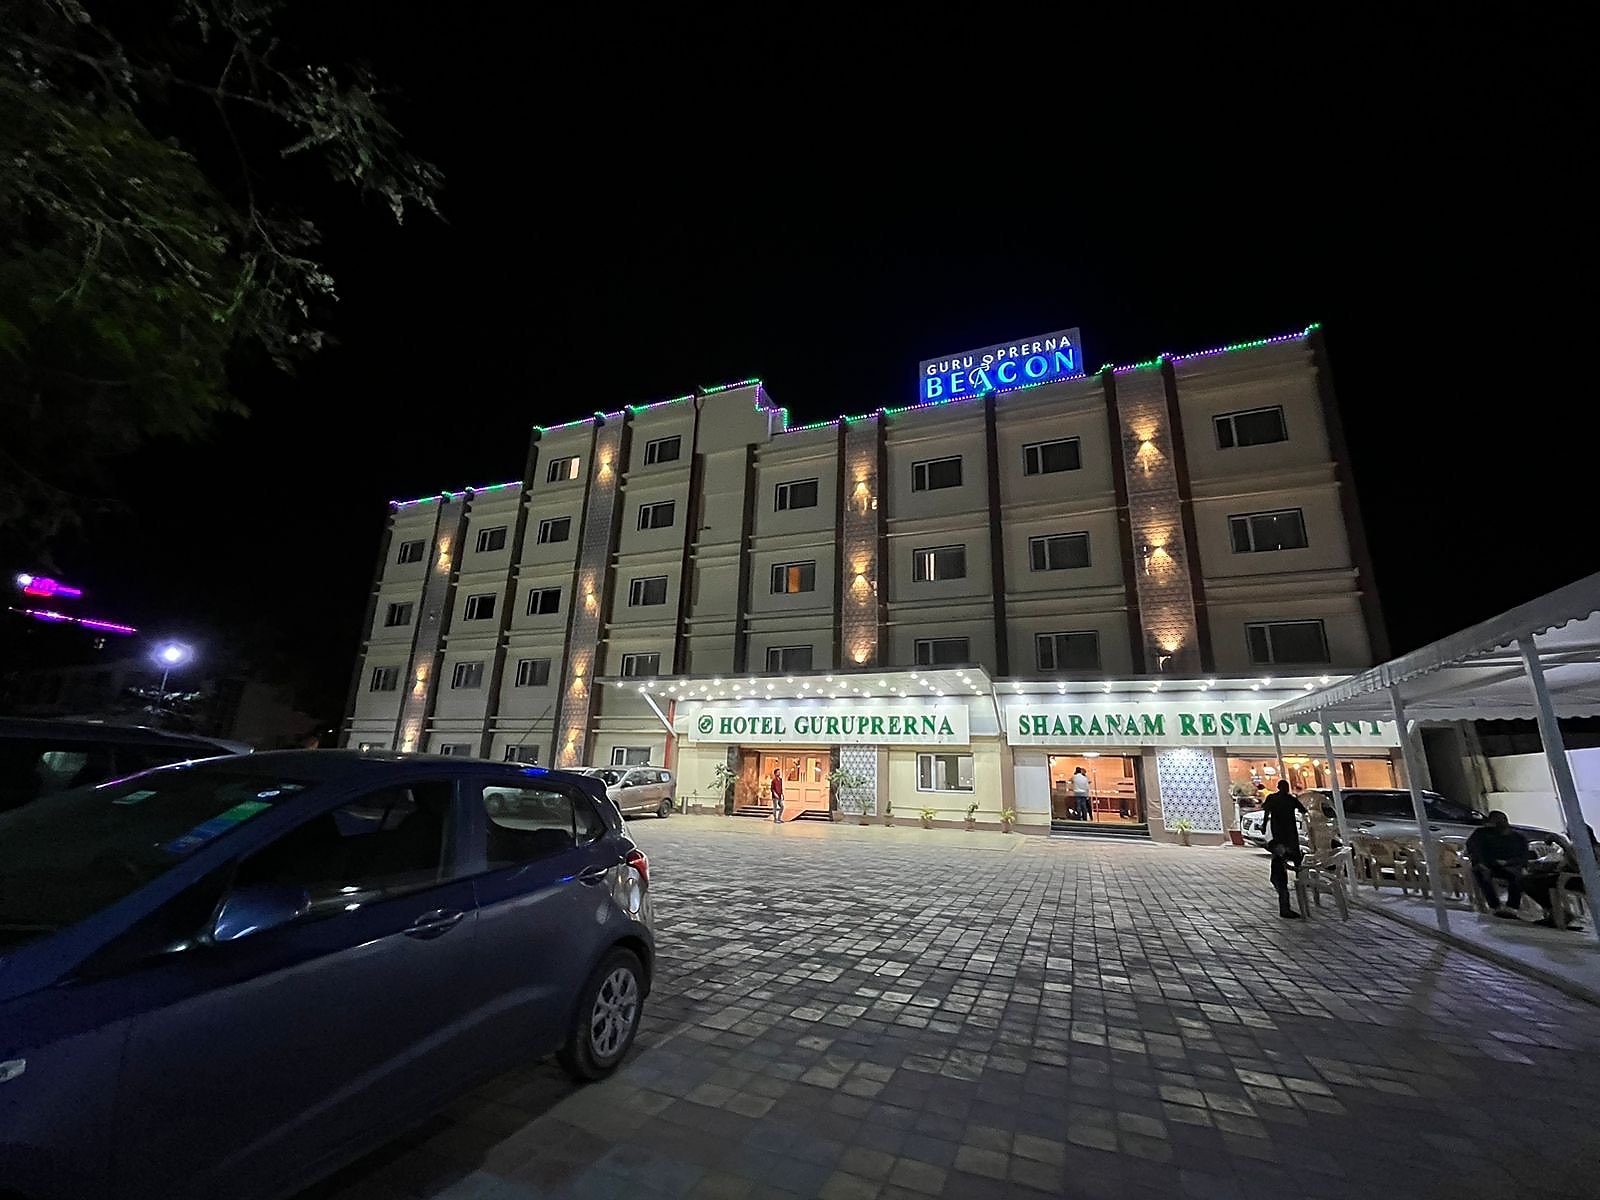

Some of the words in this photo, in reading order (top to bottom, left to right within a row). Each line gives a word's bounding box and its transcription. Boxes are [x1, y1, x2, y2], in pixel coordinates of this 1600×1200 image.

[926, 356, 974, 376] GURU
[997, 335, 1071, 360] PRERNA
[926, 349, 1075, 399] BEACON
[719, 715, 786, 735] HOTEL
[794, 714, 955, 735] GURUPRERNA
[1017, 713, 1166, 736] SHARANAM
